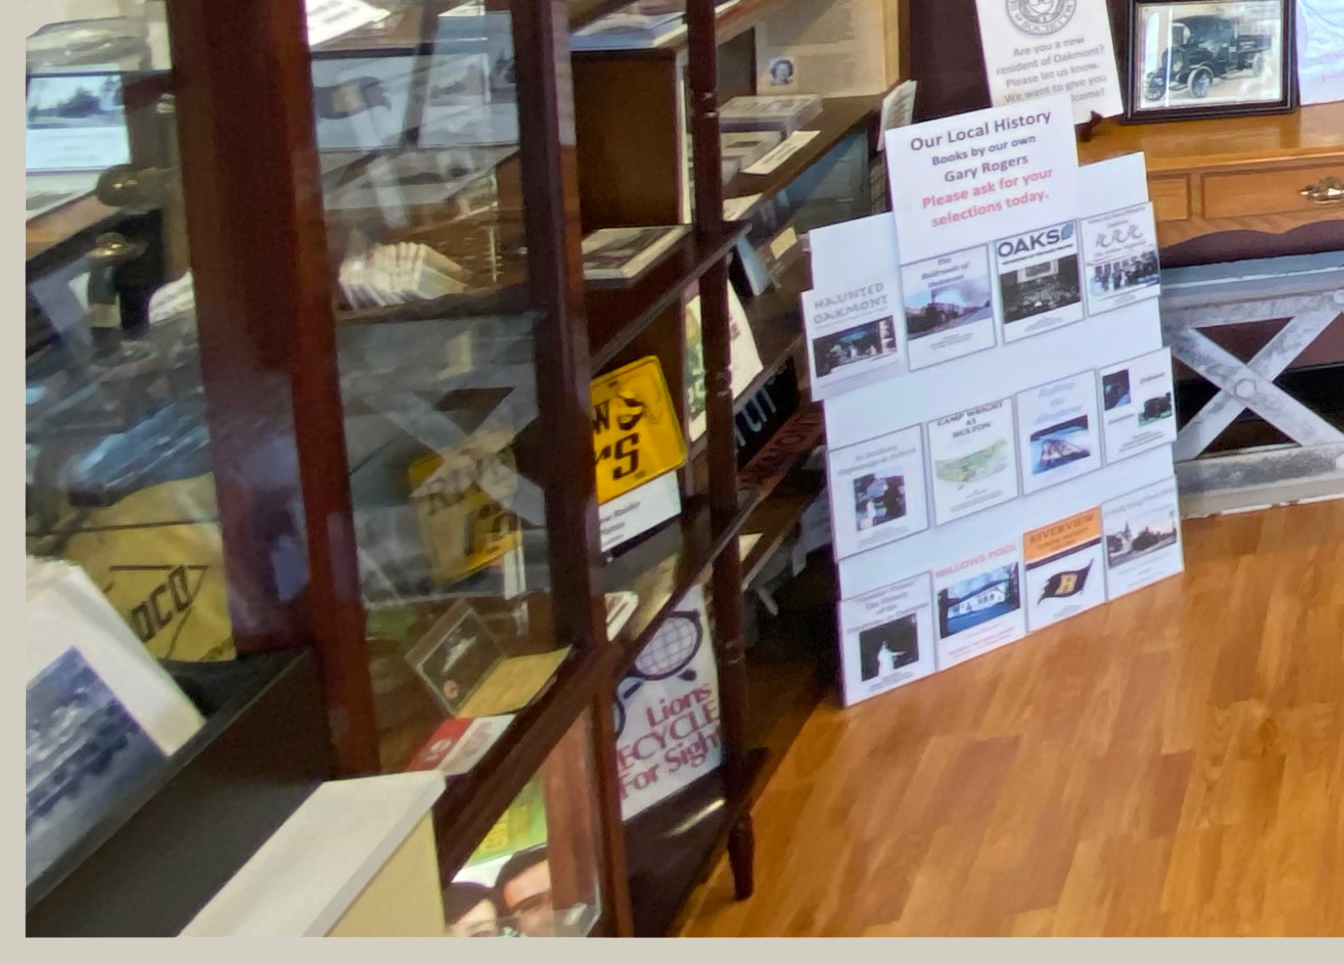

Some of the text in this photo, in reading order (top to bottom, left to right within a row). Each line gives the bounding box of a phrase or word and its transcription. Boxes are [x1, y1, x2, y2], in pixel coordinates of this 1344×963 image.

[996, 44, 1105, 76] resident of Oakmont?
[1013, 45, 1032, 57] Are
[1033, 42, 1053, 54] you
[1063, 37, 1085, 47] new
[1004, 74, 1107, 104] We want to give you
[1005, 61, 1101, 88] Please let us know.
[911, 111, 1052, 152] Our Local History
[931, 134, 1037, 167] Books by our own
[944, 154, 1029, 183] Gary Rogers
[922, 168, 1053, 209] Please ask for your
[931, 189, 1050, 228] selections today.
[998, 228, 1061, 258] OAKS
[813, 294, 889, 325] OAKMONT
[814, 281, 885, 310] HAUNTED
[937, 413, 965, 427] CAMP
[1028, 513, 1095, 543] RIVERVIEW
[646, 683, 712, 728] Lions
[617, 700, 720, 770] ECYCLE
[664, 732, 721, 775] Sigh
